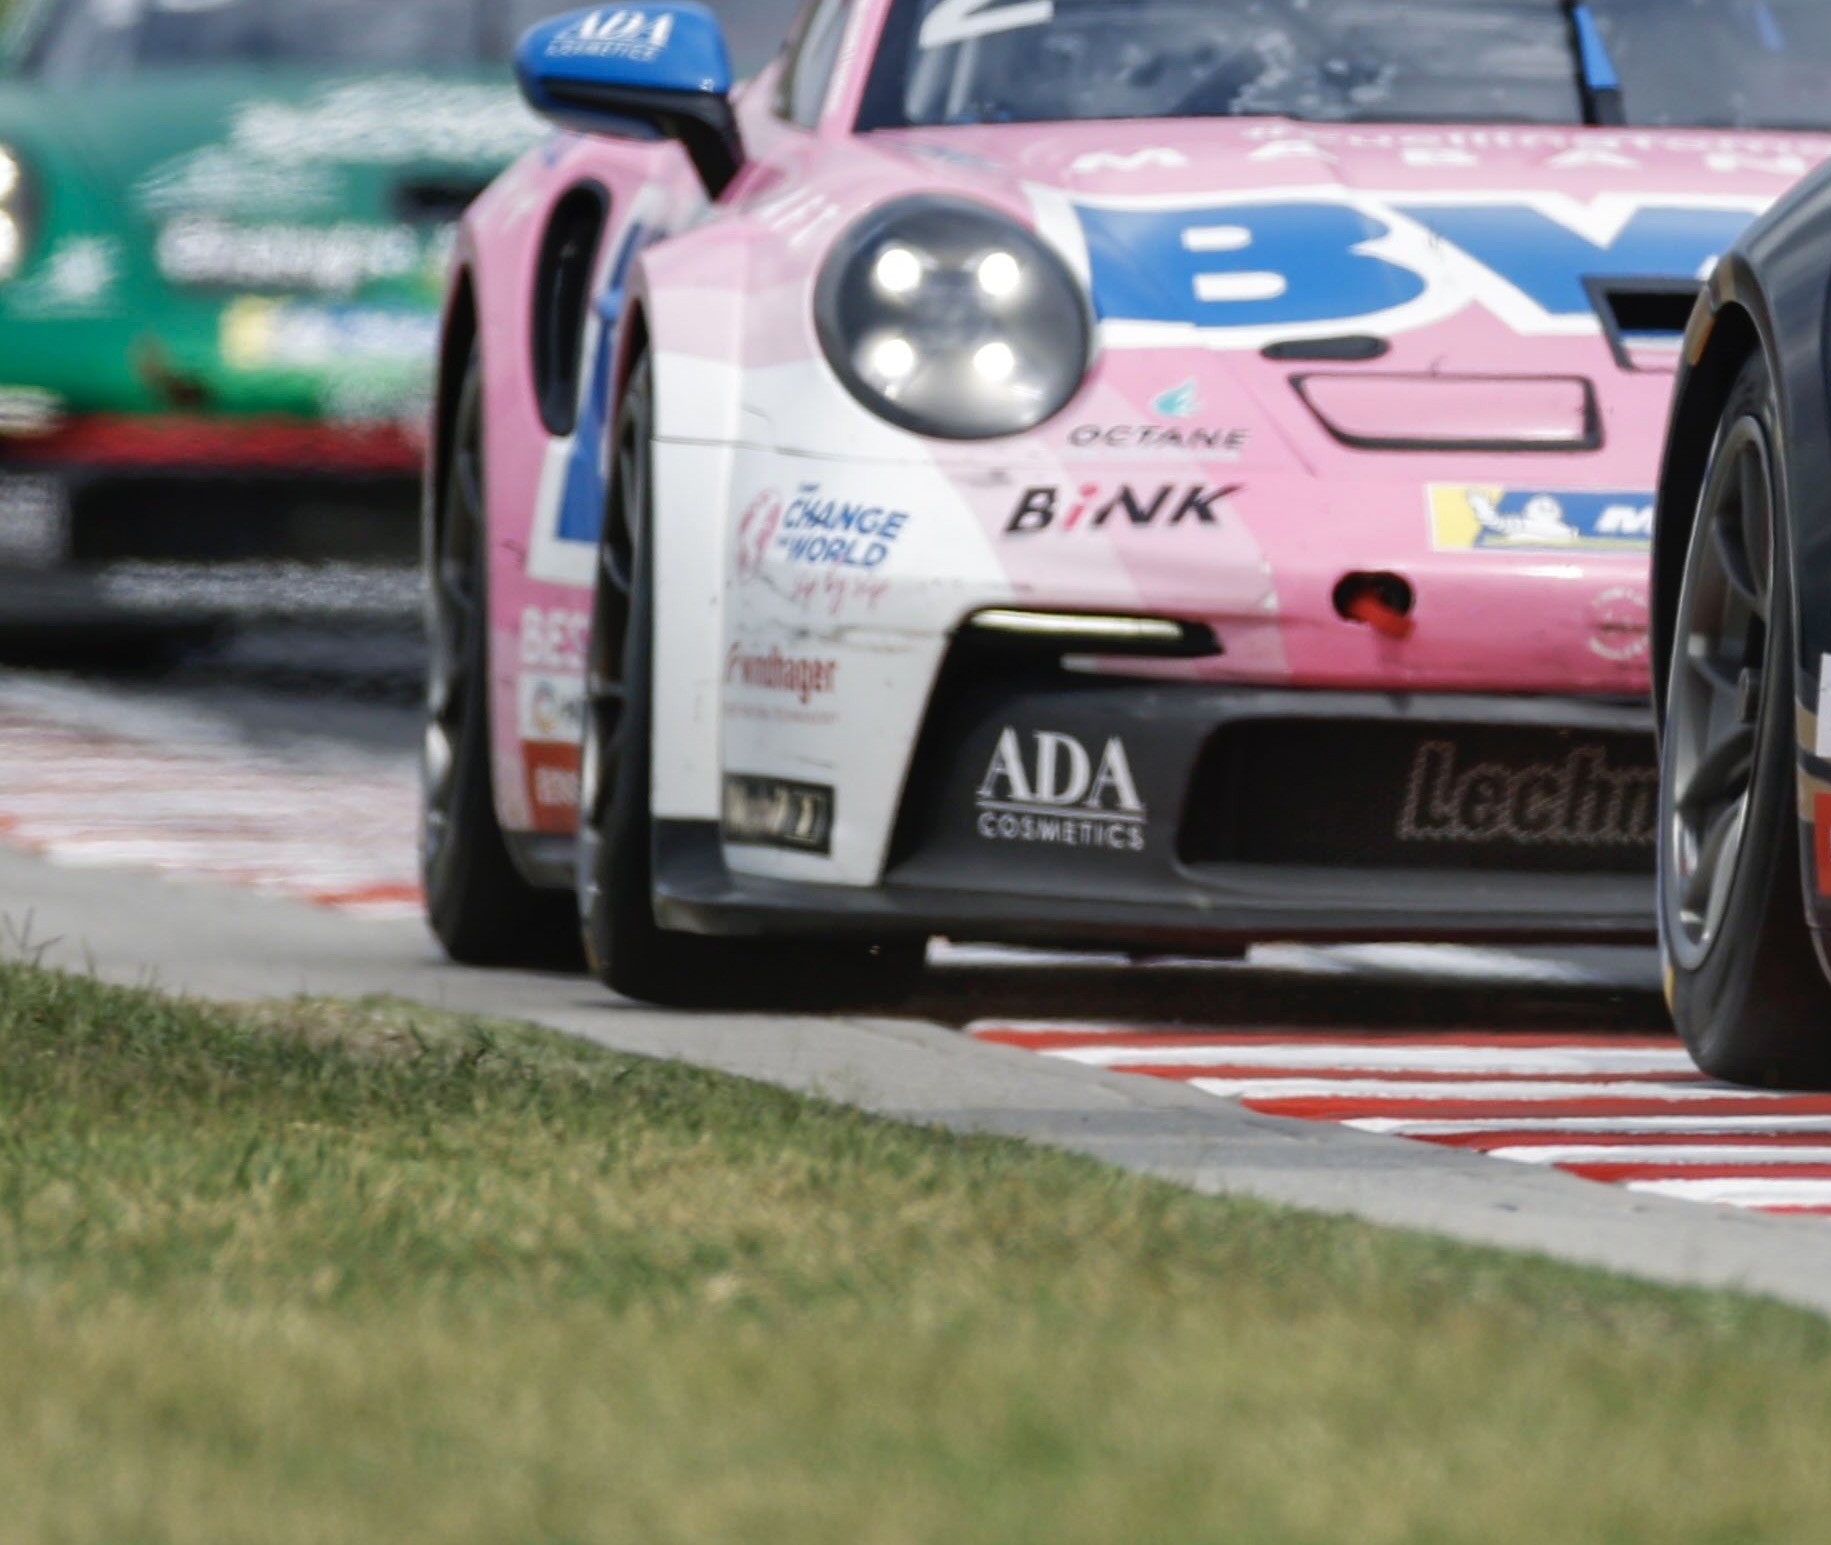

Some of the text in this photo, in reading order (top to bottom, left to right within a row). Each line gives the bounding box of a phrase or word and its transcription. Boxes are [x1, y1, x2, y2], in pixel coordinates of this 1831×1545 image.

[554, 9, 674, 48] ADA
[1069, 424, 1250, 449] OCTANE
[784, 498, 910, 539] CHANGE
[787, 534, 888, 568] WORLD
[976, 725, 1147, 812] ADA
[977, 810, 1146, 851] COSMETICS
